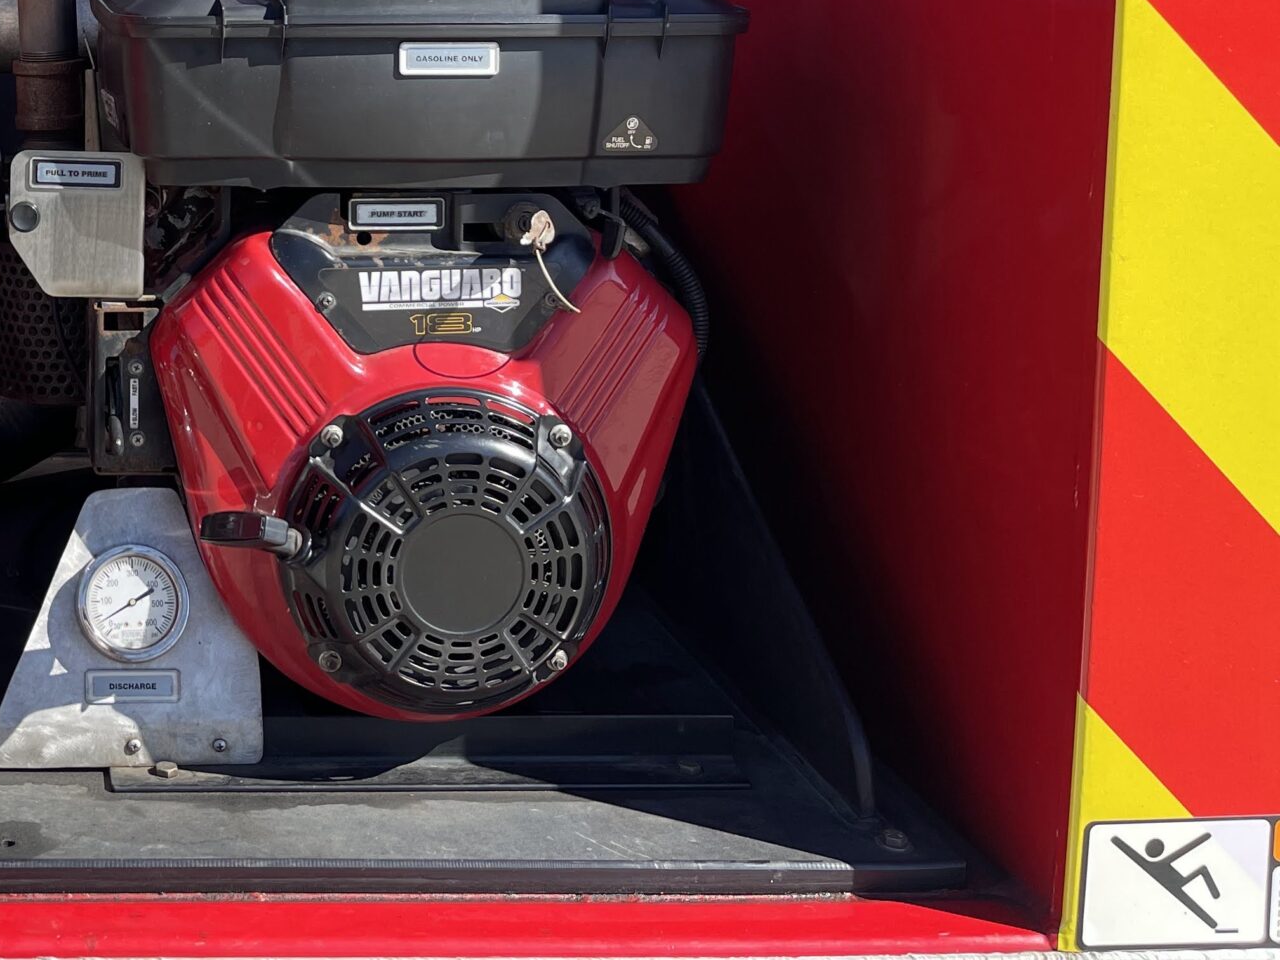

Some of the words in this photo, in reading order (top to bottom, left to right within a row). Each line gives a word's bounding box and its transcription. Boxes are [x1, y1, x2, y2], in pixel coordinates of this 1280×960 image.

[415, 55, 459, 63] GASOLINE
[461, 55, 484, 63] ONLY
[45, 169, 66, 177] PULL
[370, 210, 395, 218] PUMP
[397, 210, 425, 218] START
[410, 312, 472, 336] 18
[126, 569, 139, 577] 300
[106, 580, 119, 588] 200
[146, 580, 159, 588] 400
[101, 596, 112, 605] 100
[151, 599, 164, 608] 500
[109, 682, 157, 690] DISCHARGE
